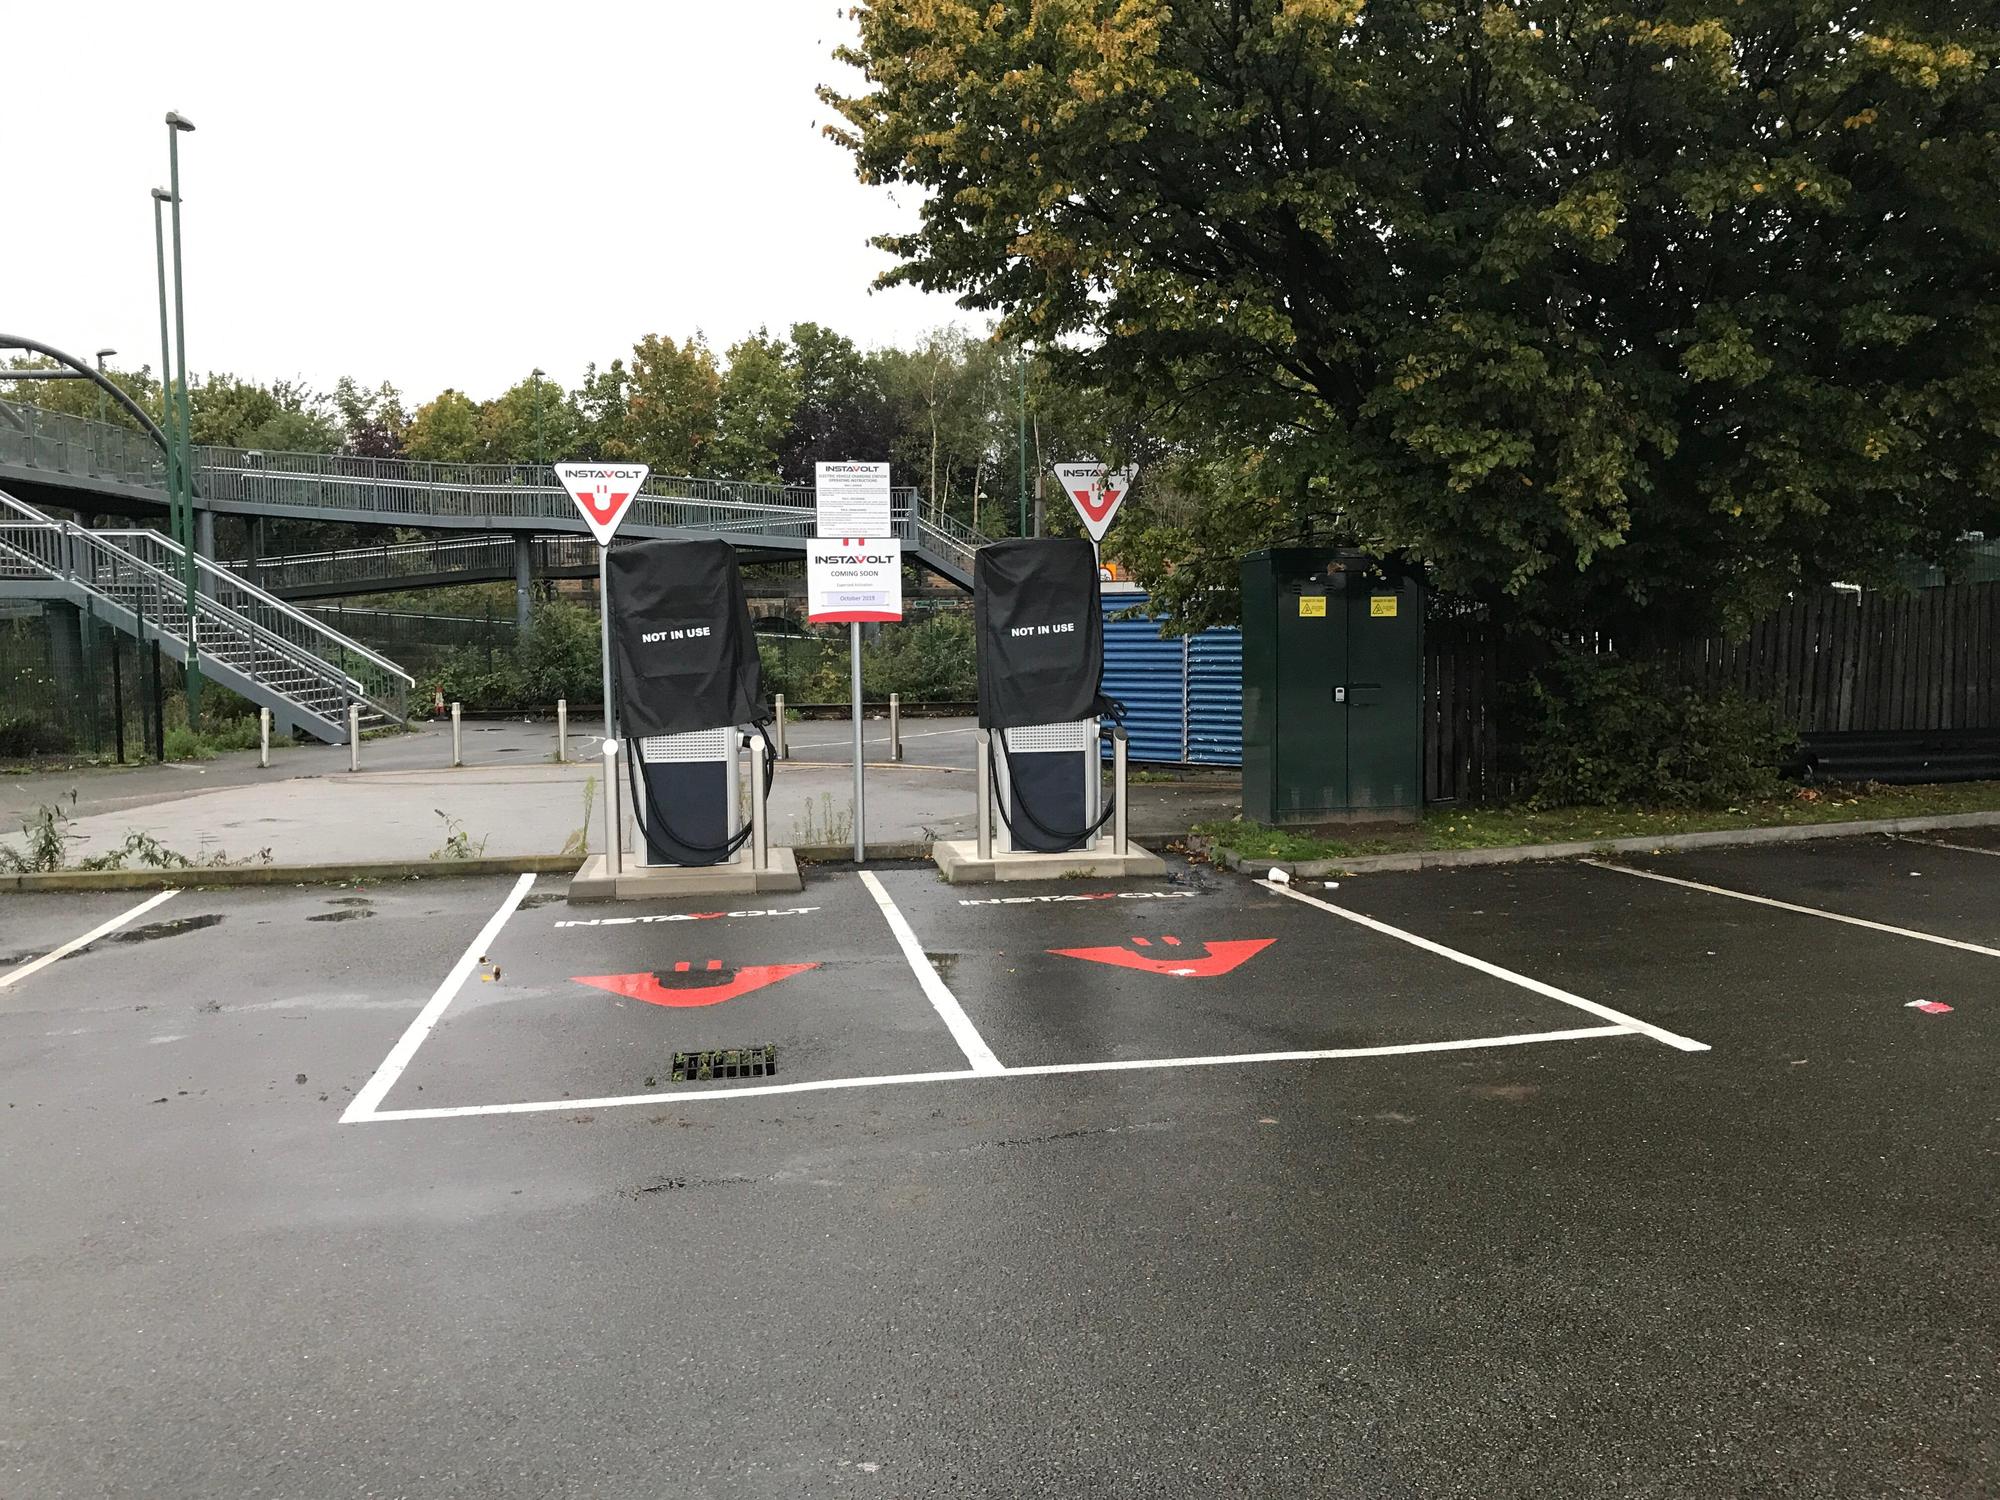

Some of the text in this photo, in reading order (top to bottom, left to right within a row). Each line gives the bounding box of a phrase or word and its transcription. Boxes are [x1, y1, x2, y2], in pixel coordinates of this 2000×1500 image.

[565, 469, 642, 479] INSTAVOLT
[825, 465, 880, 473] INSTAVOLT
[815, 555, 895, 565] INSTAVOLT
[642, 626, 711, 643] NOT IN USE
[1011, 623, 1075, 637] NOT IN USE
[957, 891, 1198, 906] INSTAVOLT
[554, 906, 821, 928] INSTAVOLT
